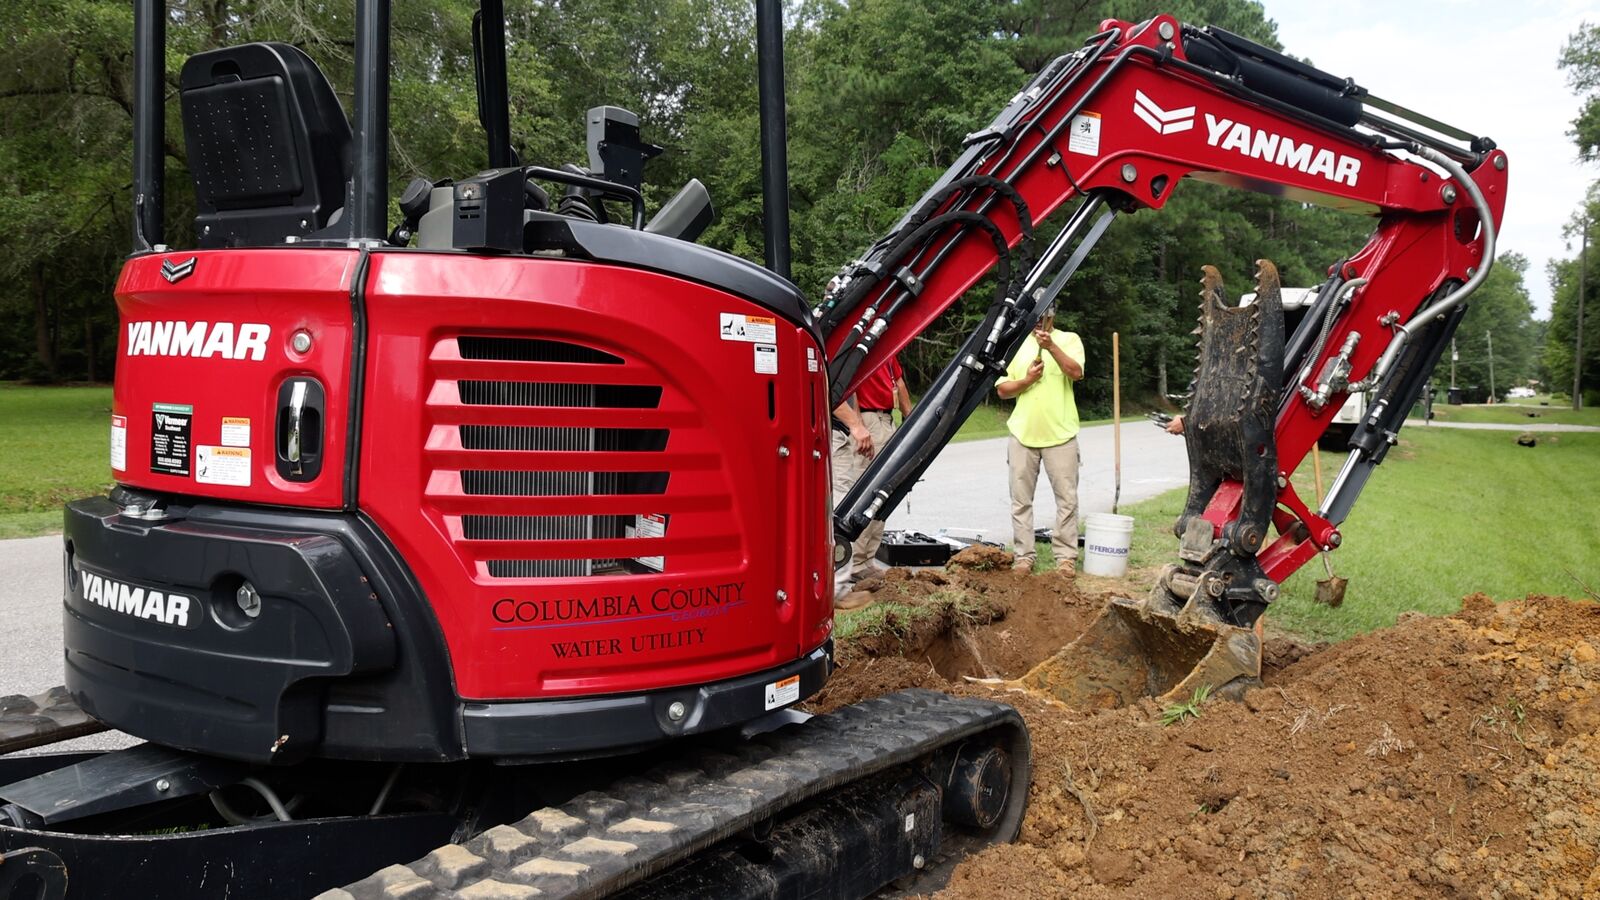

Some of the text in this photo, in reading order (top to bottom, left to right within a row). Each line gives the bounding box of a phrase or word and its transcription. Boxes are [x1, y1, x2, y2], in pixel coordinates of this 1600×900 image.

[1204, 113, 1362, 187] YANMAR
[127, 321, 271, 361] YANMAR
[81, 570, 190, 627] YANMAR
[492, 582, 745, 623] COLUMBIA COUNTY
[551, 628, 708, 659] WATER UTILITY
